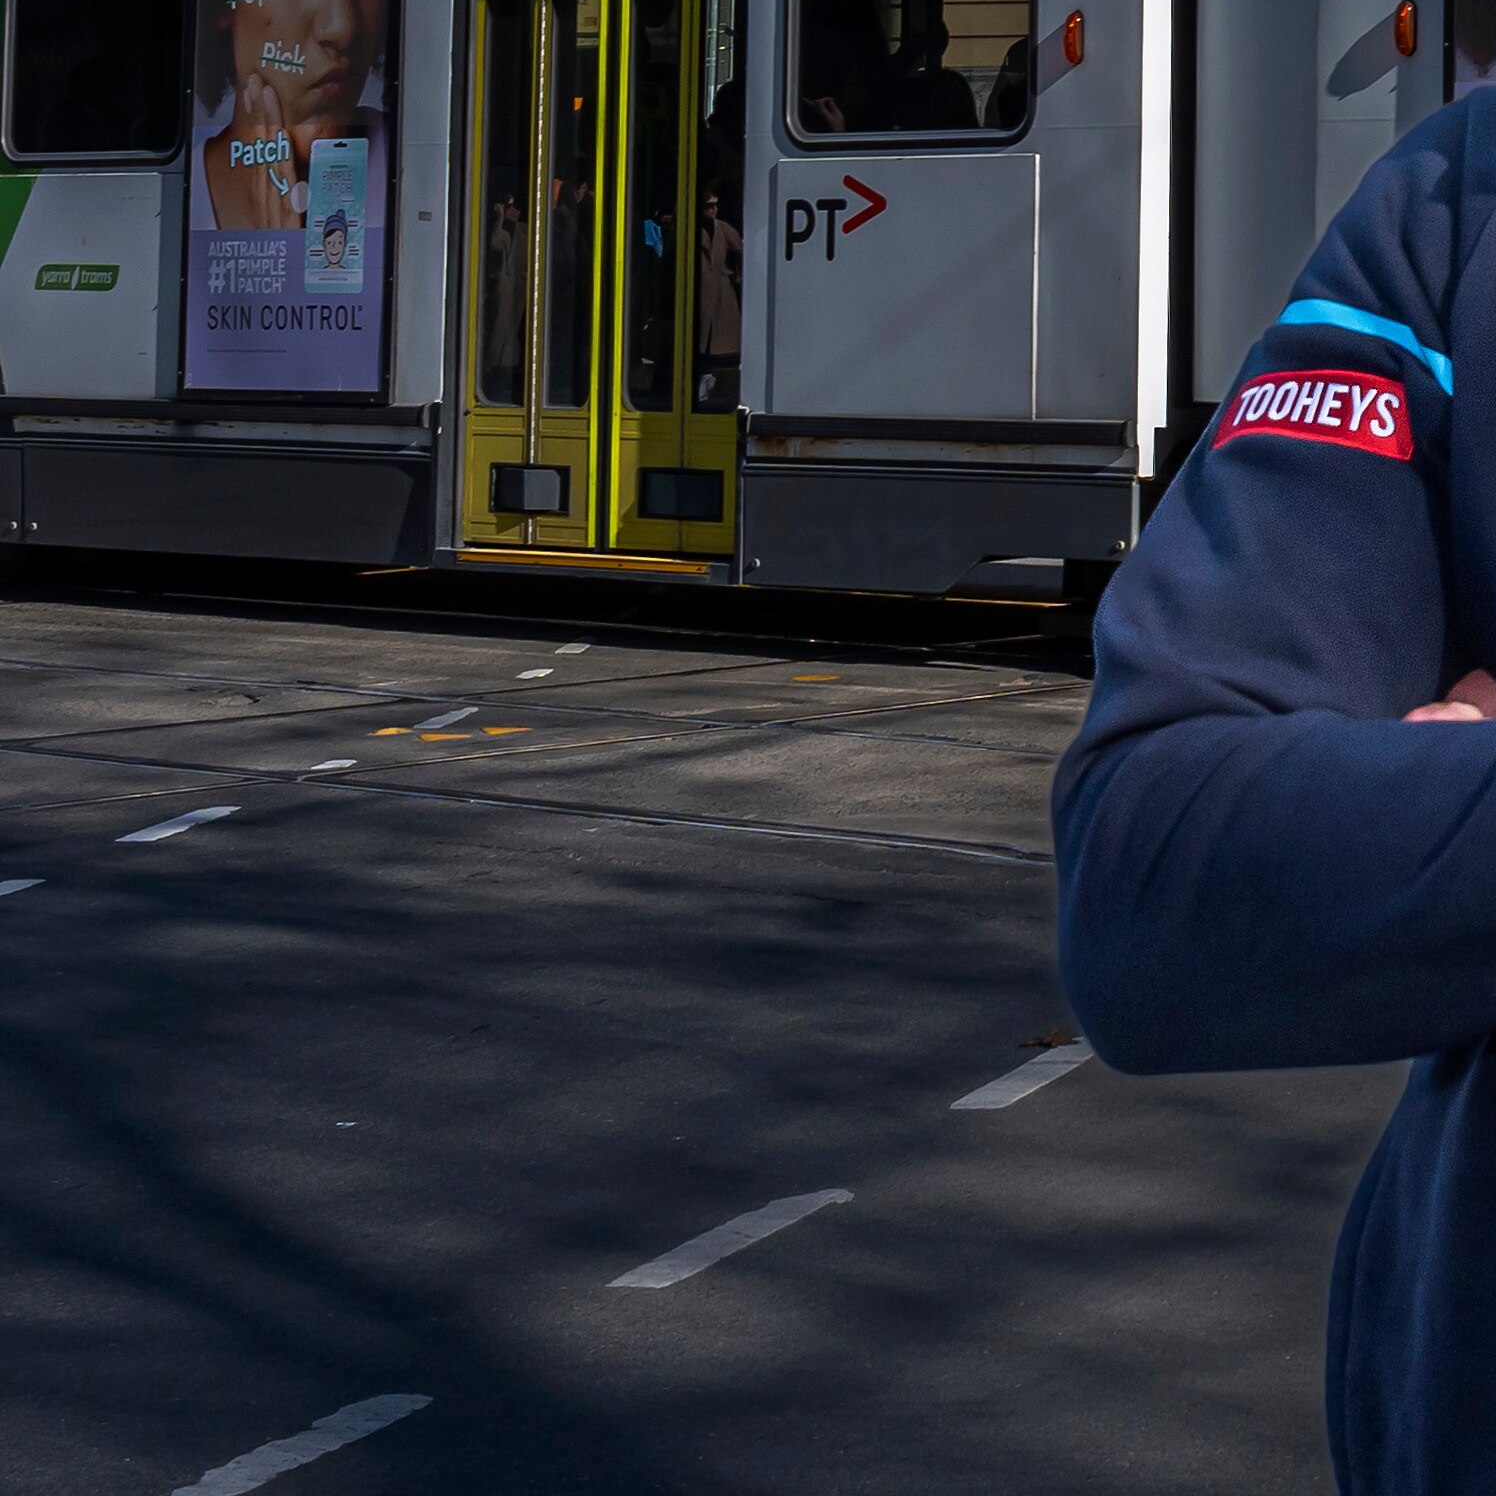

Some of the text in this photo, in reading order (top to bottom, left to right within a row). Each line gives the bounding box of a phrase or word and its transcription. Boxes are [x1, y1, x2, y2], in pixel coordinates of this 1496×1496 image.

[261, 40, 305, 74] Pick
[229, 130, 291, 168] Patch
[208, 240, 286, 257] AUSTRALIA'S
[208, 259, 236, 294] #1
[238, 259, 286, 275] PIMPLE
[238, 278, 283, 294] PATCH
[207, 305, 363, 331] SKIN CONTROL
[1232, 380, 1400, 437] TOOHEYS
